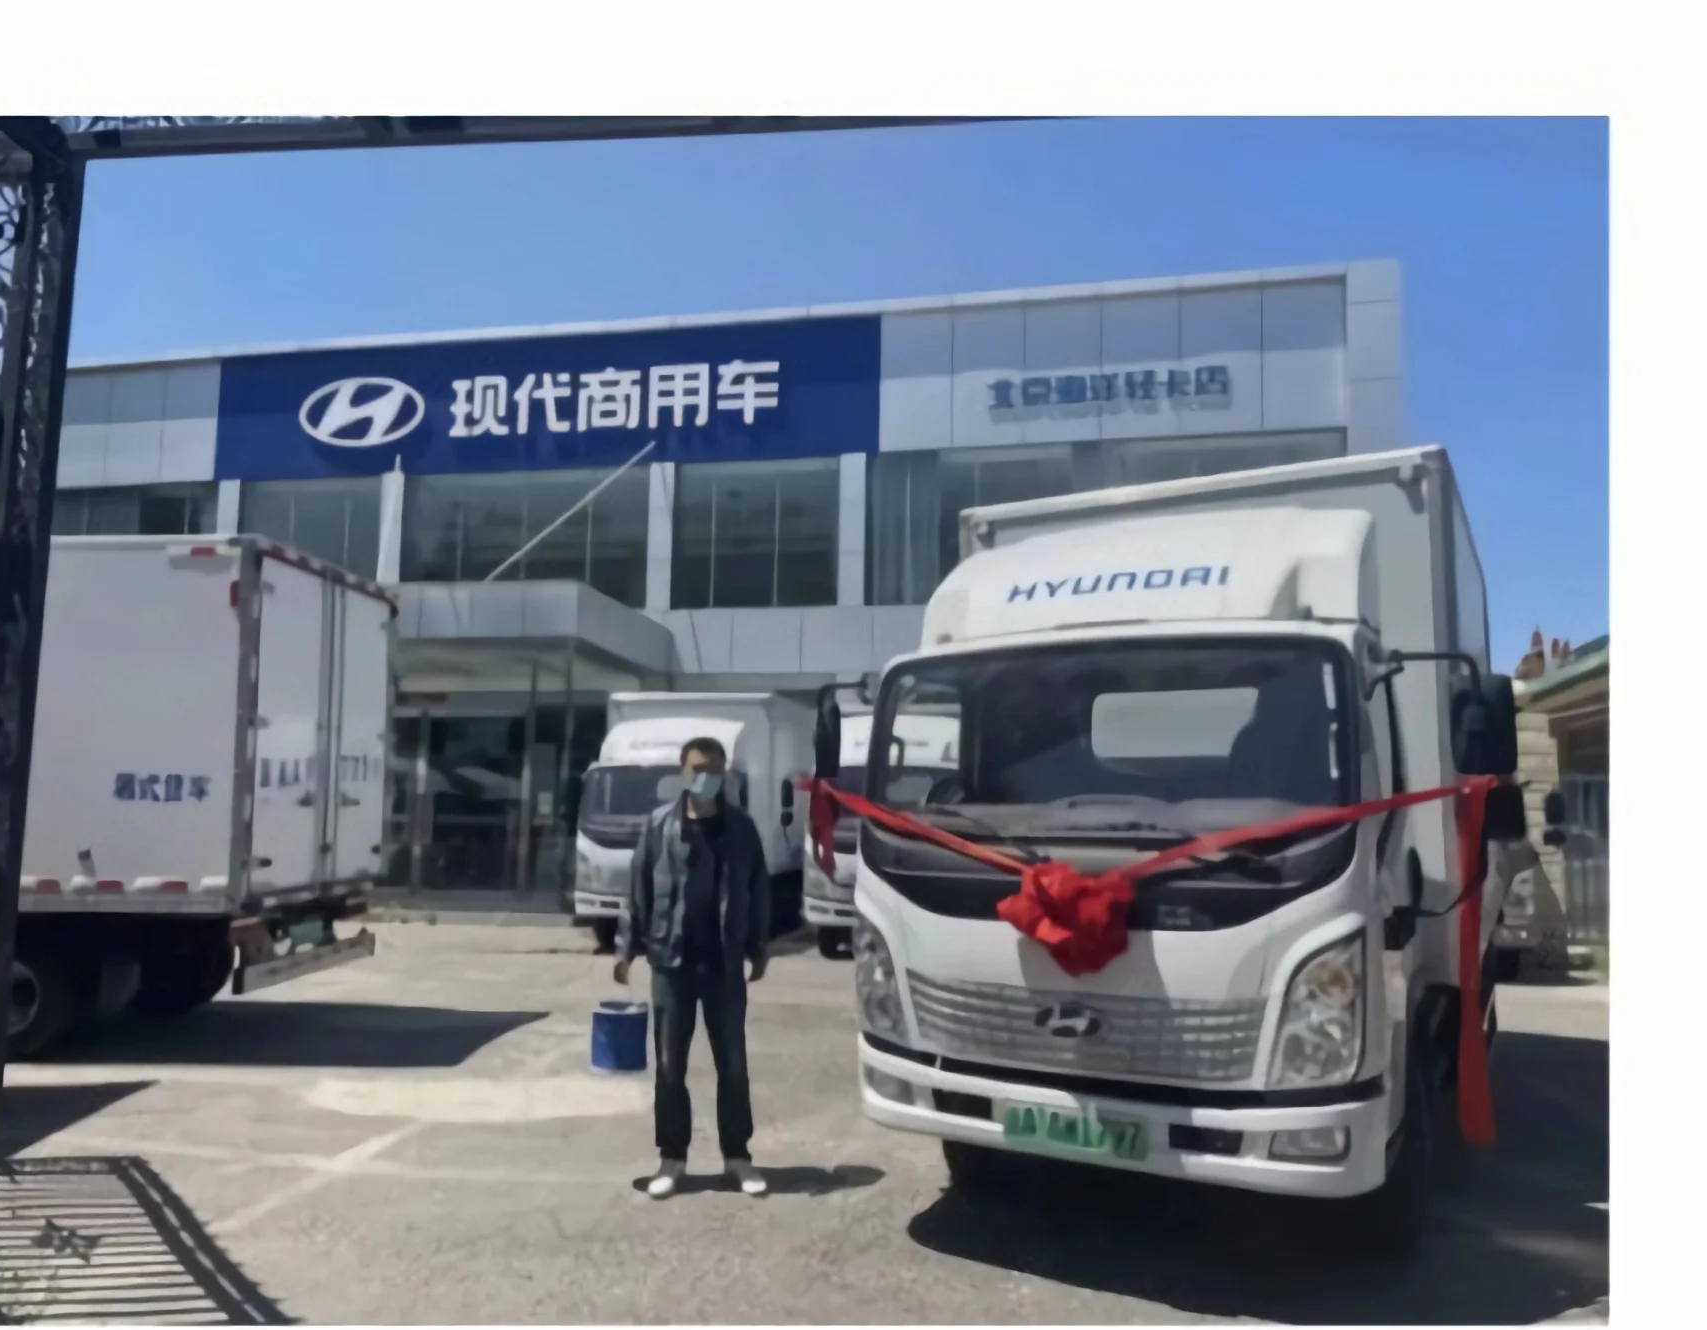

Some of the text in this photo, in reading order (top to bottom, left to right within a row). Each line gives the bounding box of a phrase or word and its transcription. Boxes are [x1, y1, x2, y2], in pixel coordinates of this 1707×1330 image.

[449, 360, 780, 437] 现代商用车
[1006, 565, 1230, 604] HYUNDAI
